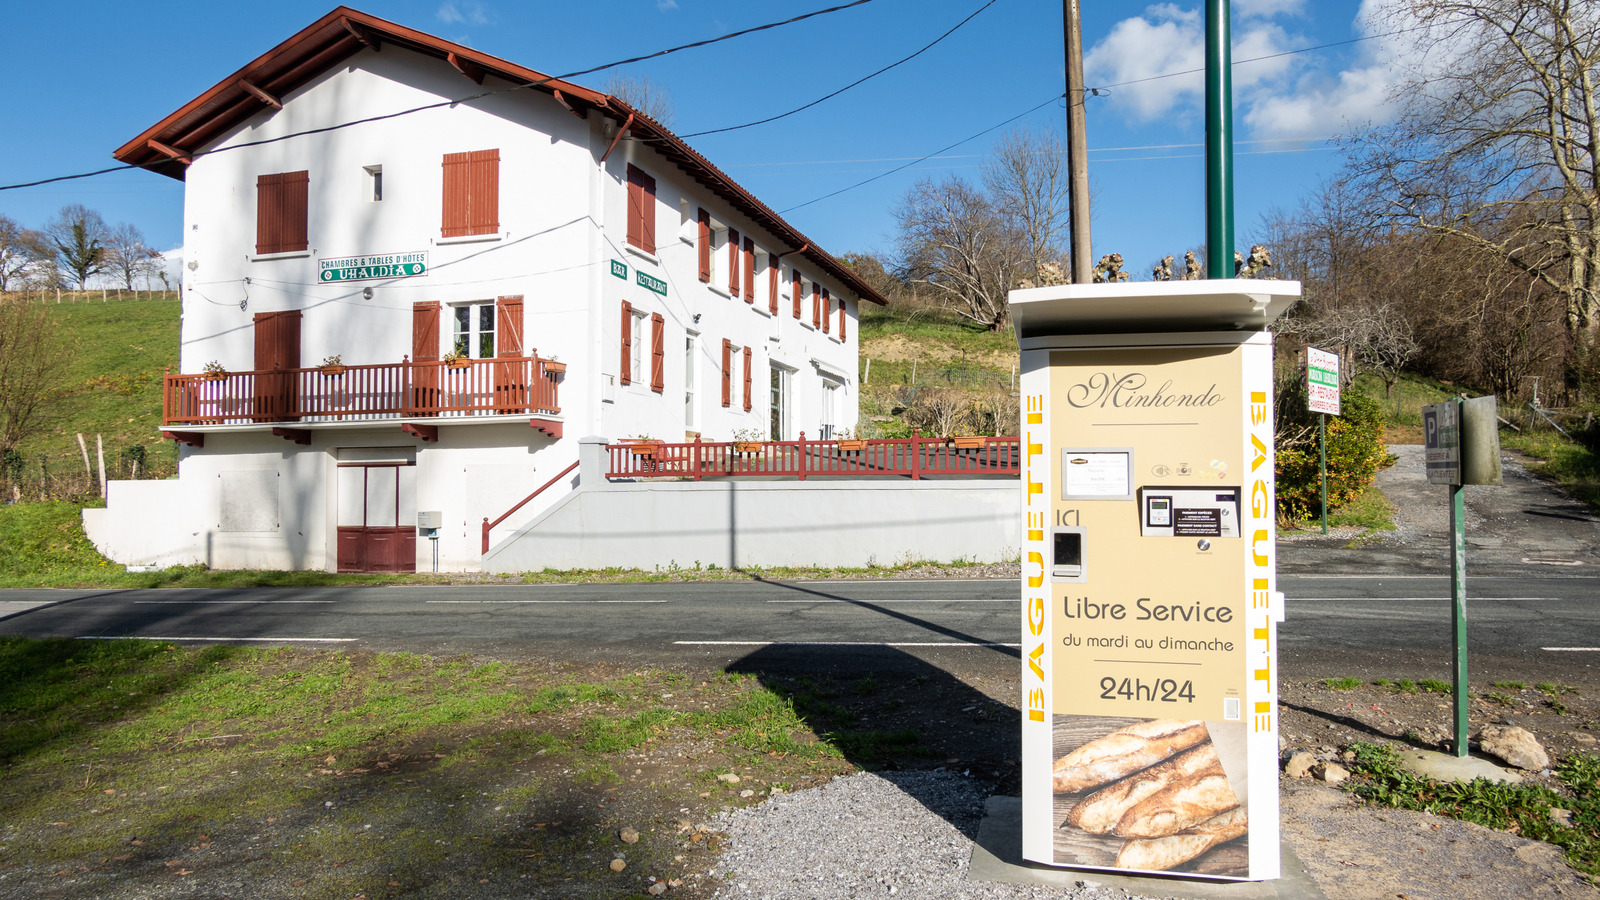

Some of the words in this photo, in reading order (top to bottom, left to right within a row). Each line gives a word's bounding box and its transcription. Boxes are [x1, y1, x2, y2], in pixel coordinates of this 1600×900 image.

[321, 258, 358, 269] CHAMBRES
[368, 255, 393, 265] TABLES
[339, 265, 407, 280] UHALDIA
[613, 261, 626, 278] BAR
[1067, 372, 1226, 409] Minhondo
[1427, 417, 1436, 444] P
[1056, 509, 1080, 527] ICI
[1026, 393, 1045, 723] BAGUETTE
[1250, 391, 1271, 733] BAGUETTE
[1063, 595, 1127, 621] Libre
[1135, 597, 1234, 624] Service
[1062, 632, 1082, 648] du
[1086, 634, 1129, 648] mardi
[1134, 637, 1154, 650] au
[1158, 635, 1235, 652] dimanche
[1099, 675, 1196, 704] 24h/24
